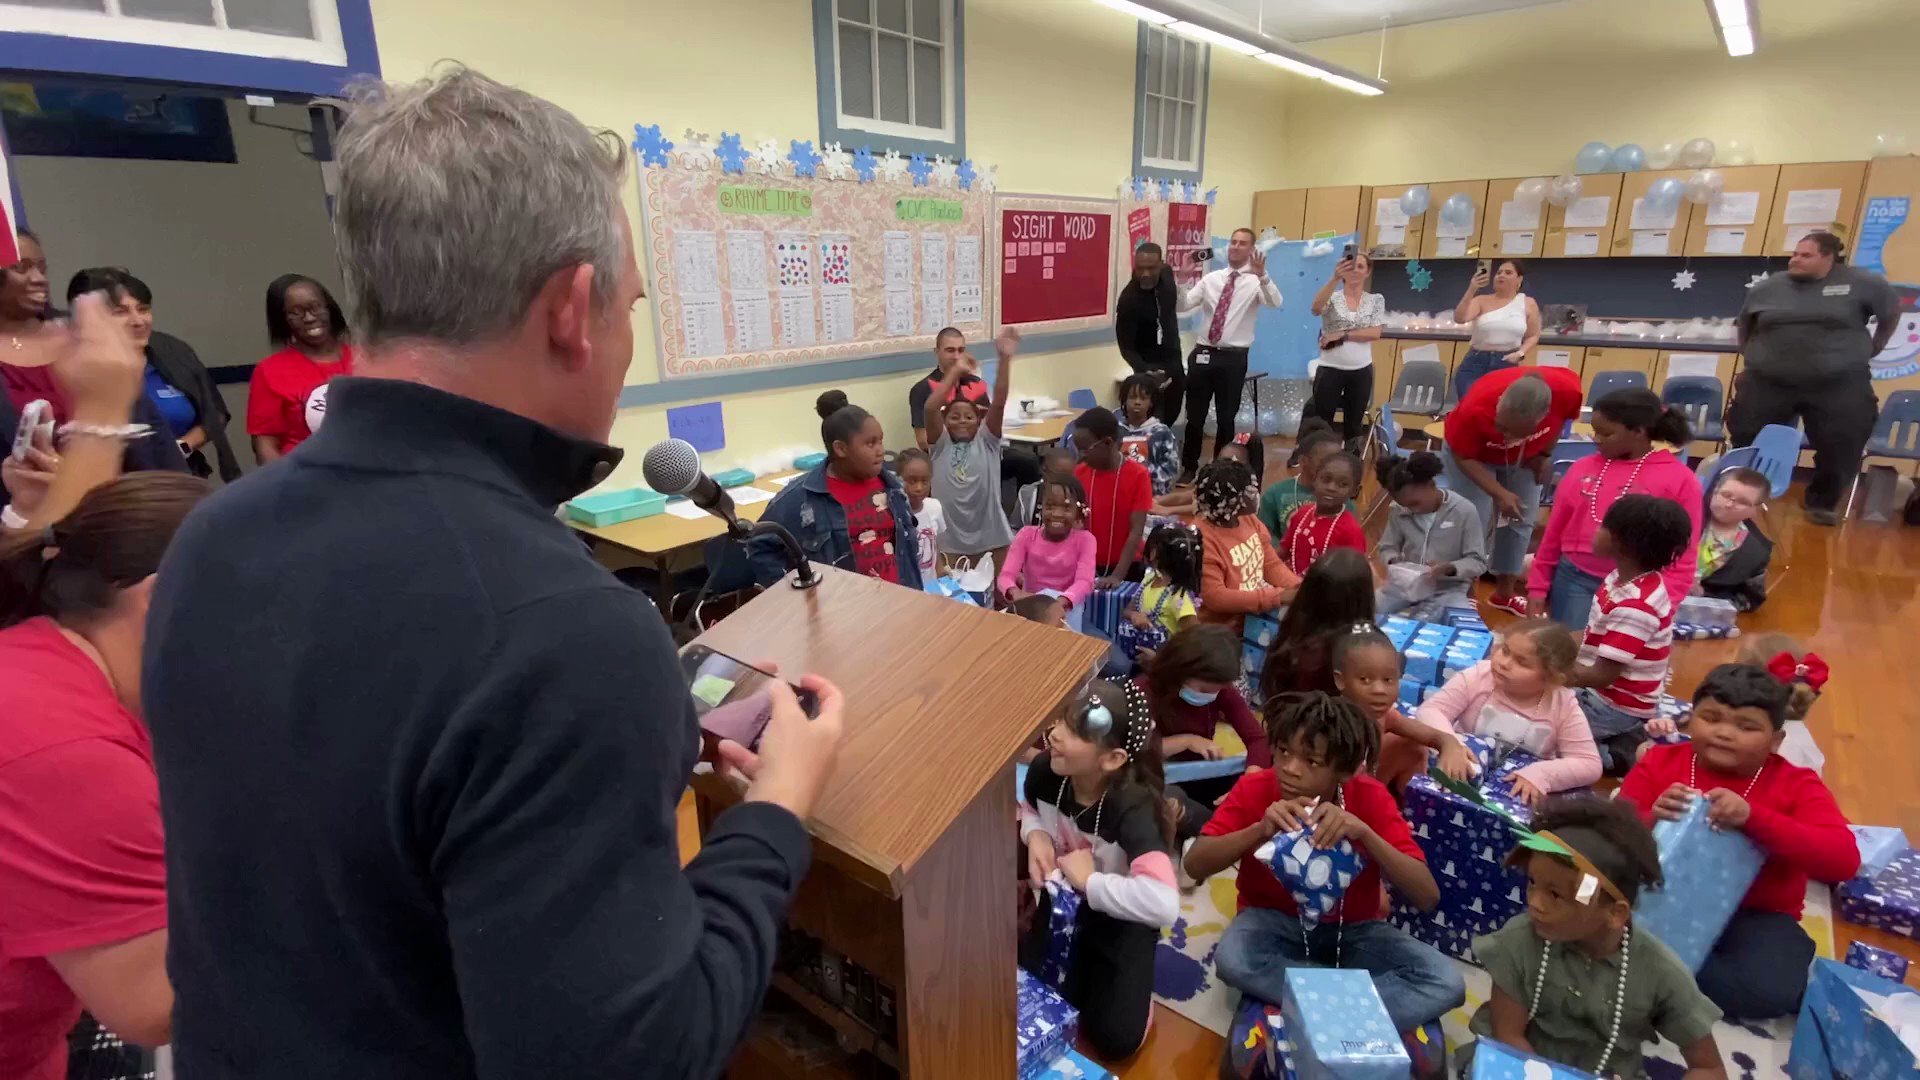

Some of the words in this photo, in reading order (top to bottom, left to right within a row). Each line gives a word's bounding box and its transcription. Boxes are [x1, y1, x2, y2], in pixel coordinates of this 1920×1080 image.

[735, 187, 773, 212] RHYME
[776, 189, 802, 213] TIME
[907, 199, 926, 219] CVC
[1012, 214, 1056, 240] SIGHT
[1063, 214, 1096, 241] WORD
[1229, 532, 1261, 567] HAVE
